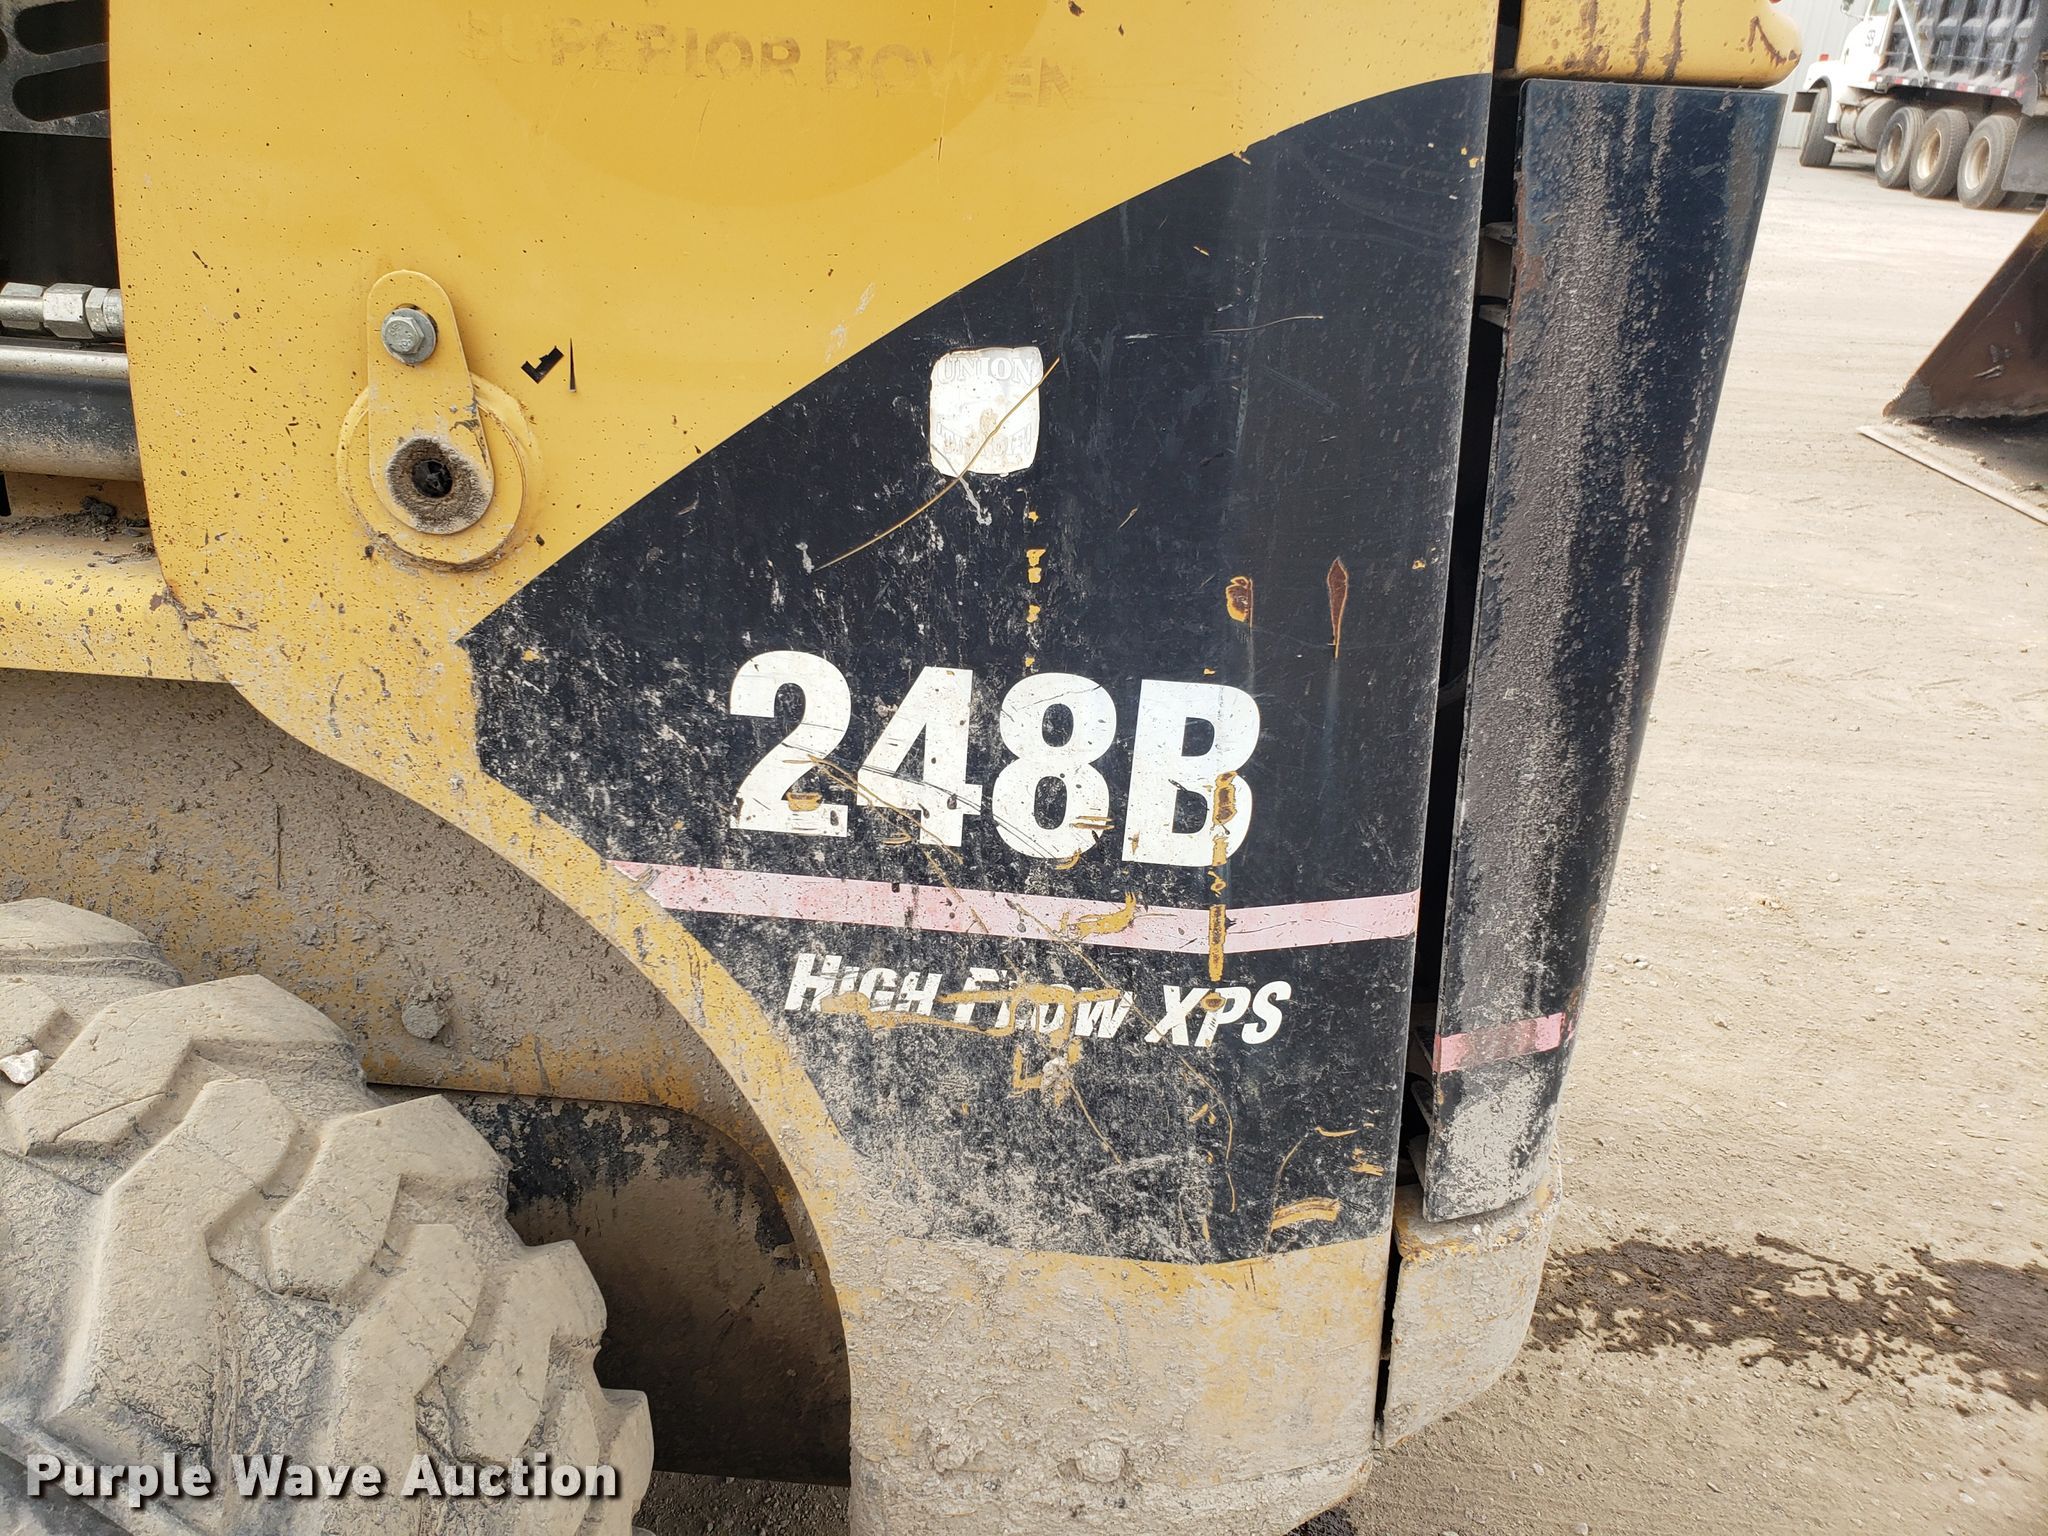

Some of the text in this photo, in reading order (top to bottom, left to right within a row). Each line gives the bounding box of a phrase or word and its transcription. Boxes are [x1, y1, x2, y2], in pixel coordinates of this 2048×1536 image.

[457, 9, 801, 88] SUPERIOR
[937, 355, 1036, 386] UNION
[729, 650, 1261, 867] 248B
[1145, 980, 1292, 1047] XPS
